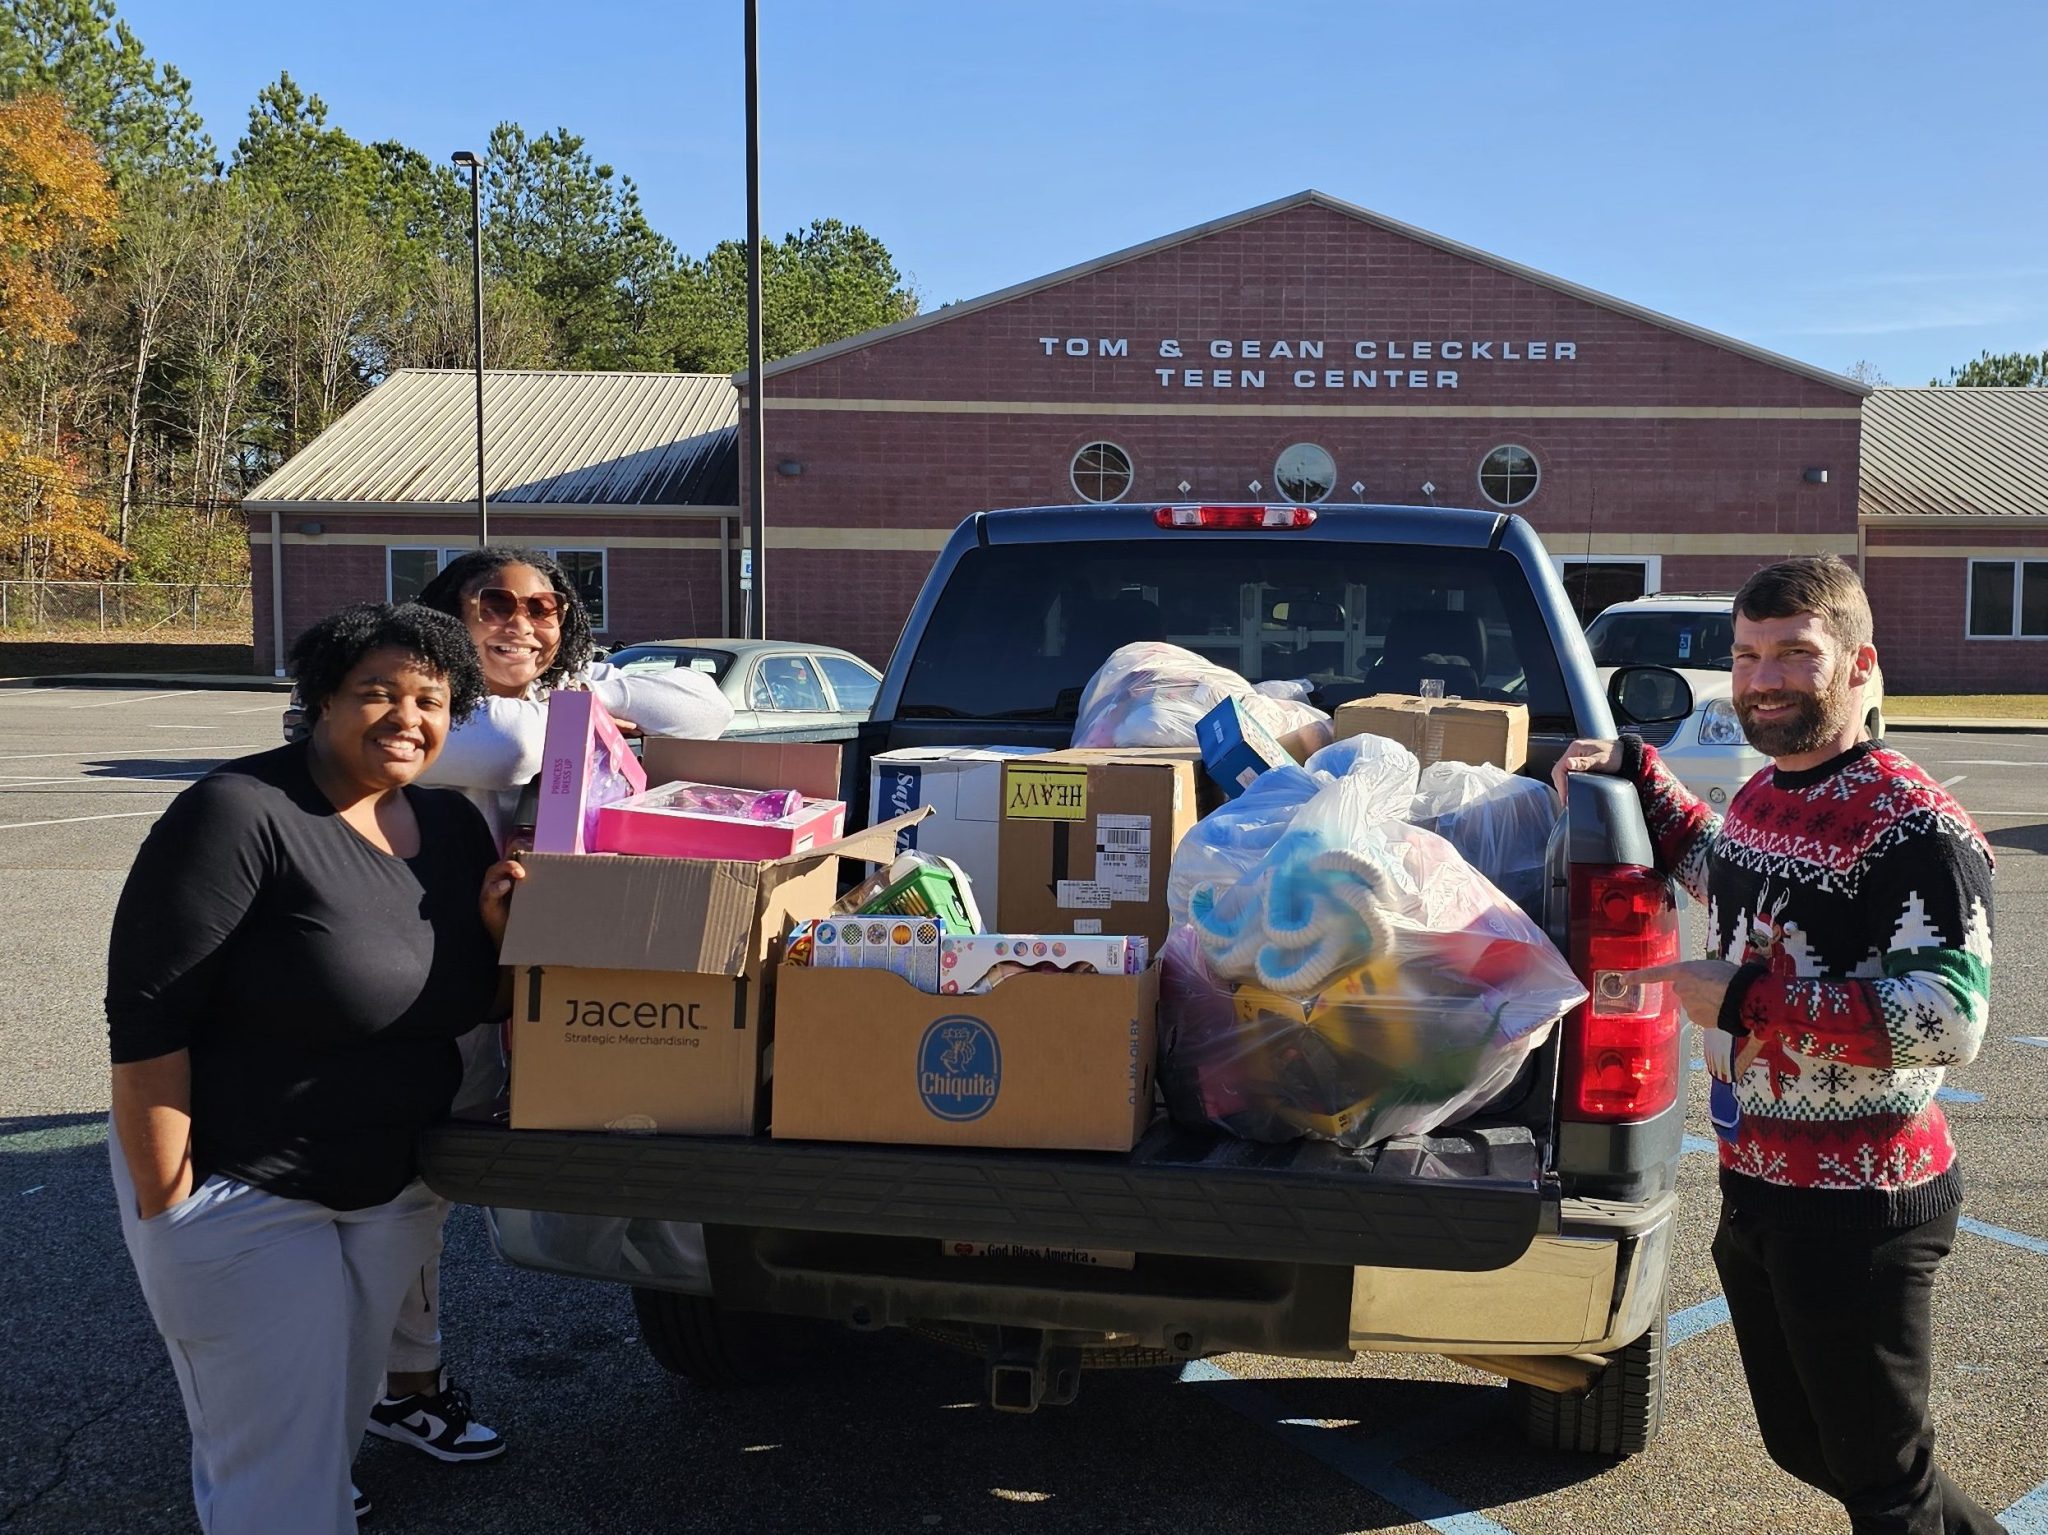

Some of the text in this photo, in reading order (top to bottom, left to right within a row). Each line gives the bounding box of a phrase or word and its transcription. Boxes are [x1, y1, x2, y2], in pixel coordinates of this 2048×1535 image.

[1039, 337, 1578, 360] TOM & GEAN CLECKLER
[1155, 369, 1460, 388] TEEN CENTER
[551, 758, 563, 795] PRINCESS
[561, 758, 573, 795] DRESS UP
[1010, 783, 1083, 808] HEAVY
[564, 1033, 700, 1047] Strategic Merchandising
[922, 1072, 995, 1101] Chiquita
[987, 1244, 1088, 1263] God Bless America
